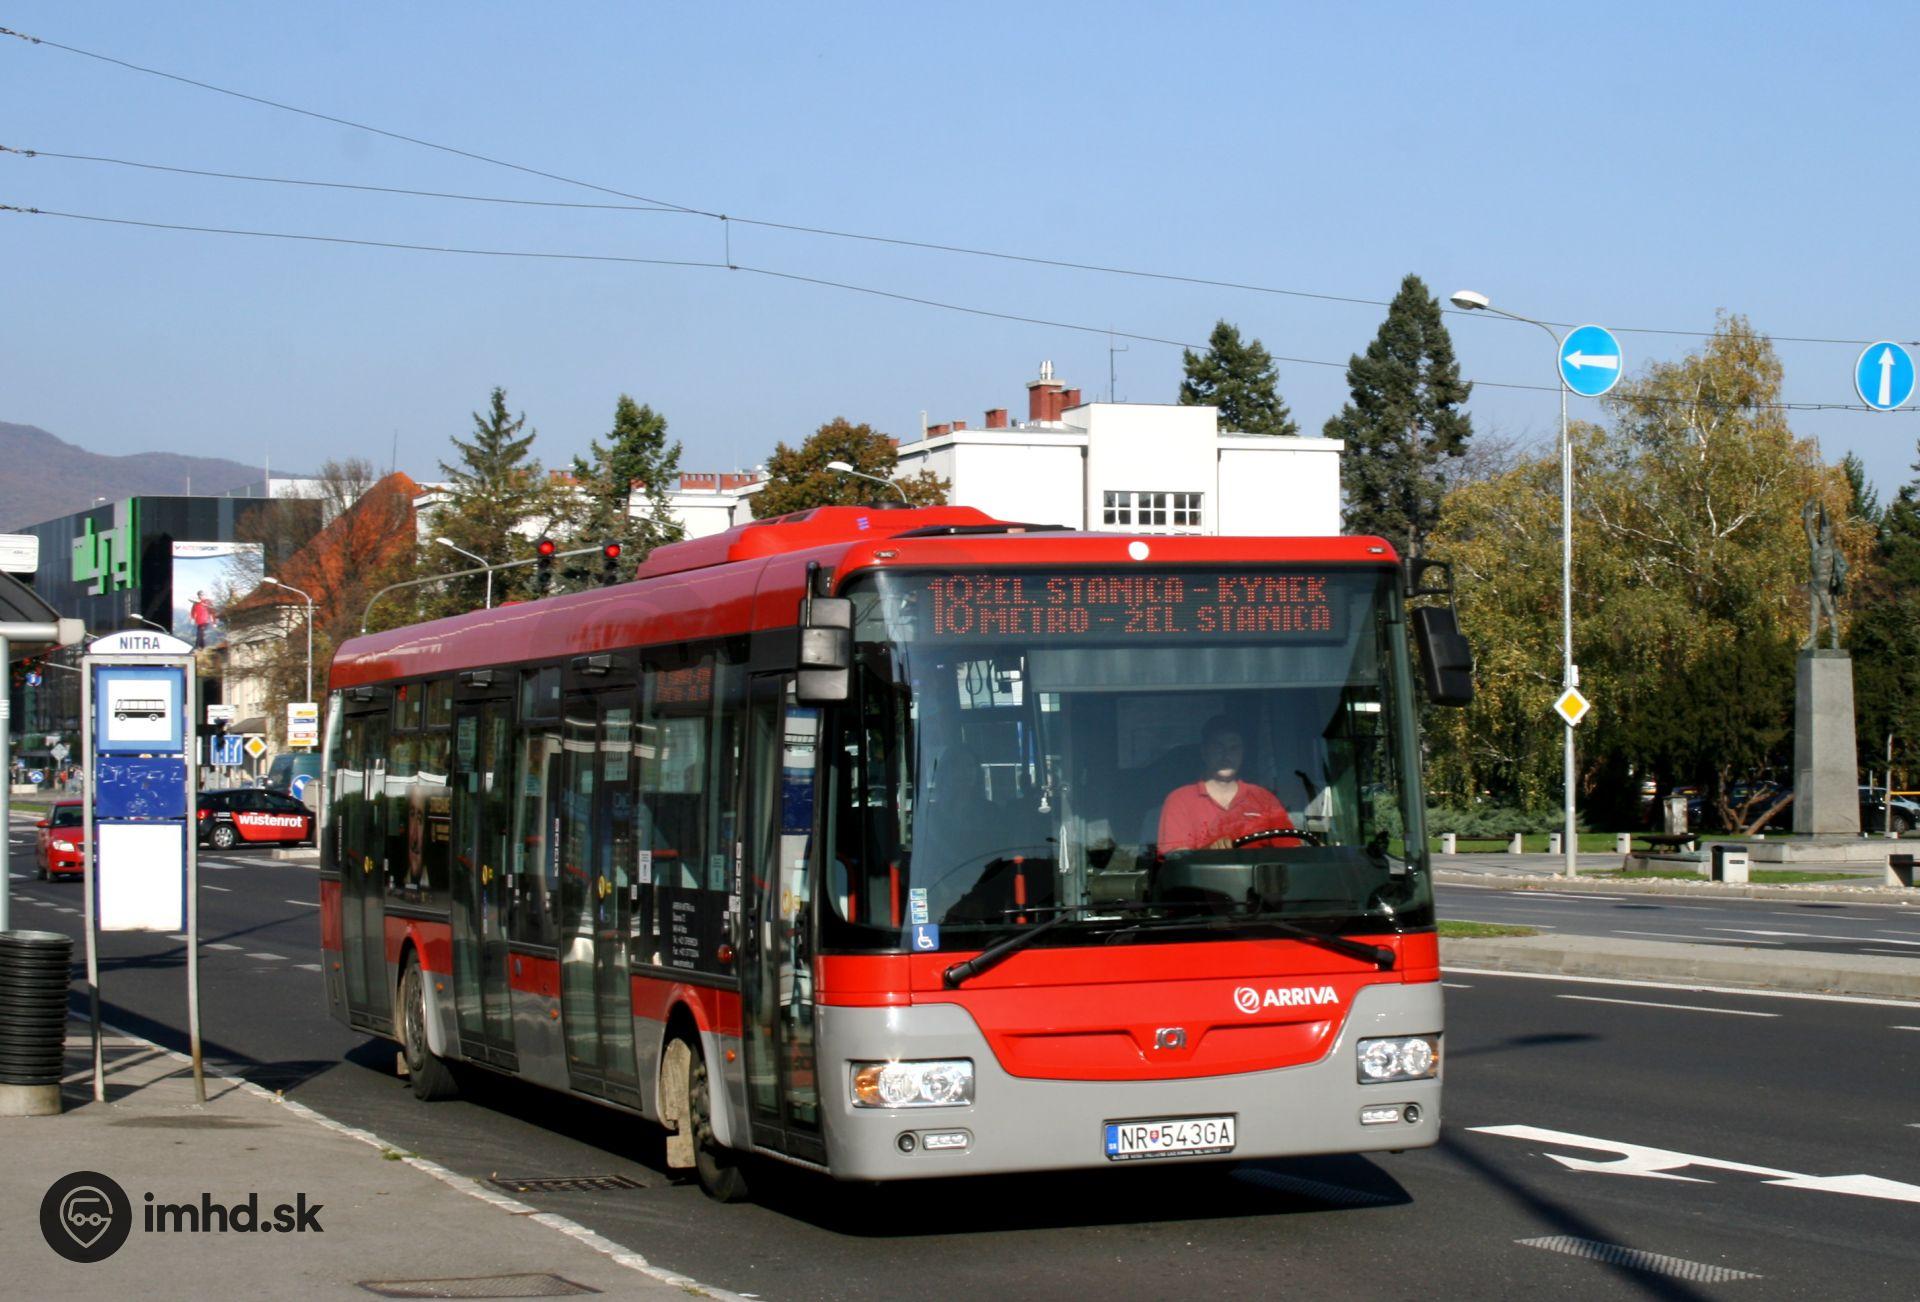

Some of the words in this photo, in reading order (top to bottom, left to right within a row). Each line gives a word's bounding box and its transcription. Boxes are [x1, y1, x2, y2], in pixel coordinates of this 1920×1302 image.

[976, 573, 1037, 604] ŽEL.
[1046, 576, 1184, 604] STANICA
[1218, 576, 1327, 604] KYNEK
[933, 604, 974, 635] 10
[980, 607, 1089, 635] METRO
[1123, 603, 1188, 633] ŽEL.
[1196, 604, 1332, 633] STANICA
[119, 636, 161, 650] NITRA
[239, 813, 303, 828] wüstenrot
[1263, 986, 1339, 1007] ARRIVA
